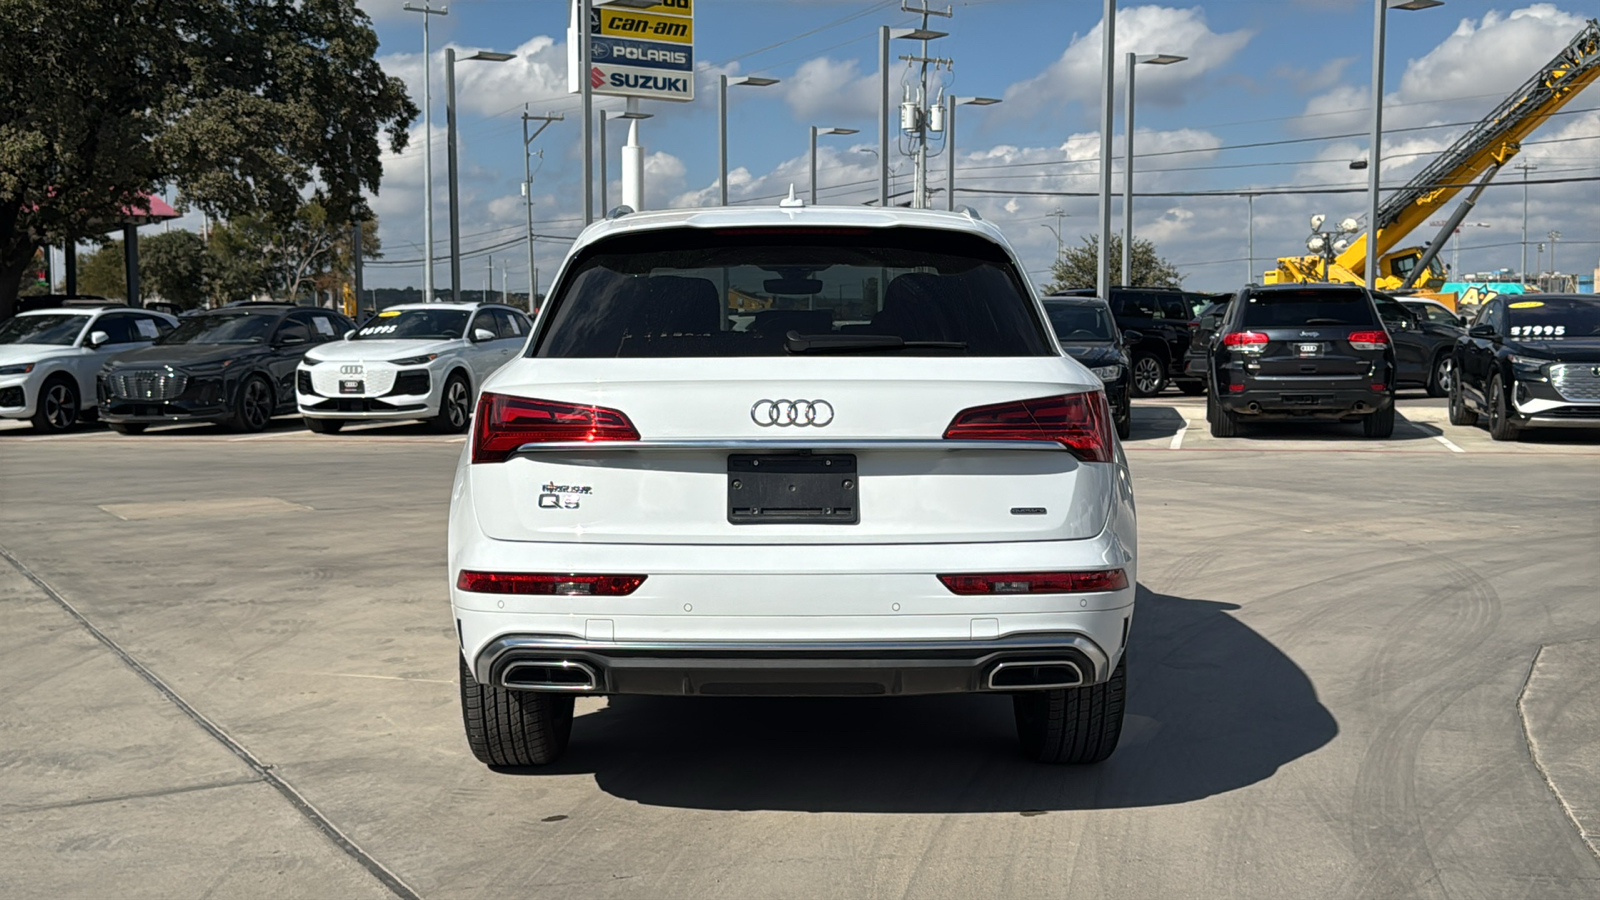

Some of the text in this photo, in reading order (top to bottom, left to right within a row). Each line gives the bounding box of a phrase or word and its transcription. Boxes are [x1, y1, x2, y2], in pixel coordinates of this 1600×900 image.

[608, 16, 688, 37] can-am
[612, 45, 687, 64] POLARIS
[609, 72, 688, 93] SUZUKI
